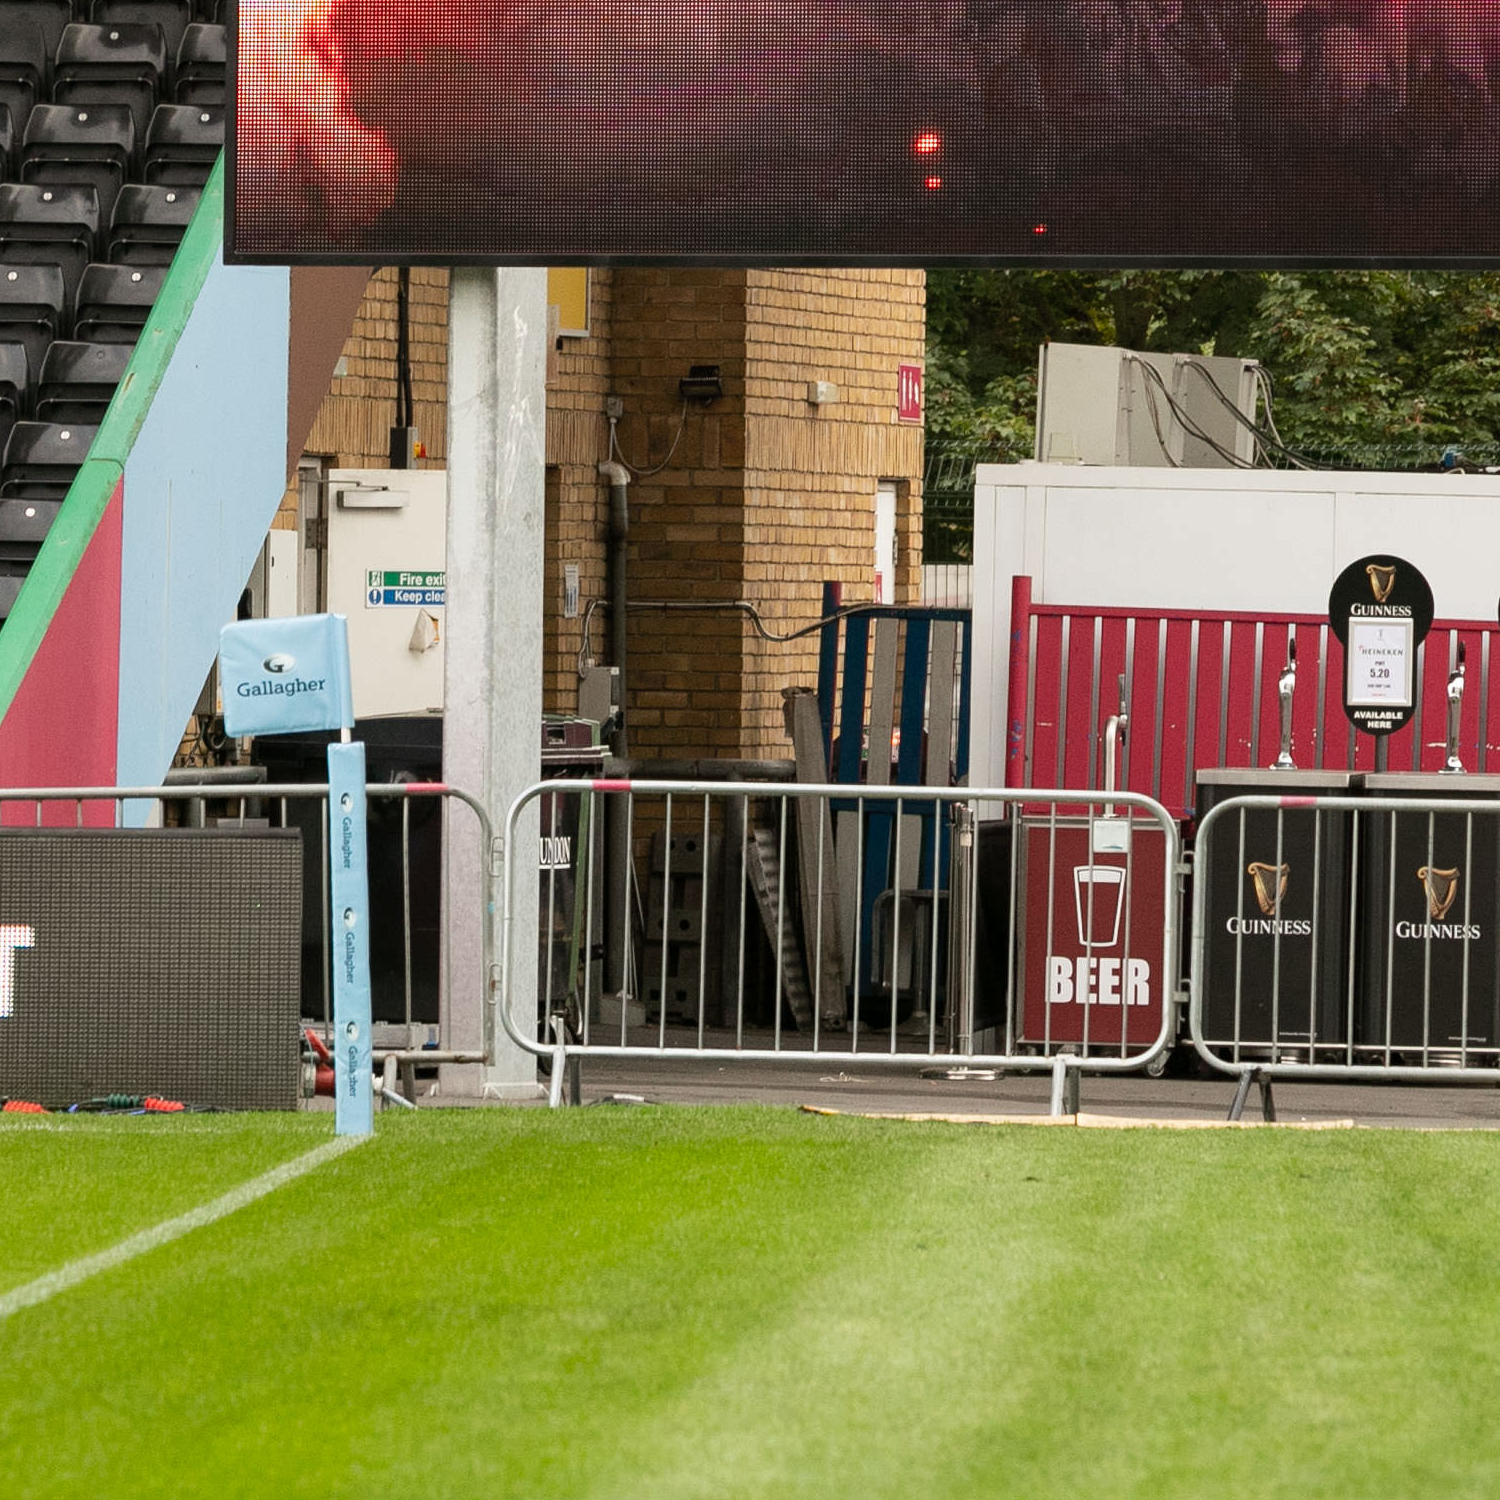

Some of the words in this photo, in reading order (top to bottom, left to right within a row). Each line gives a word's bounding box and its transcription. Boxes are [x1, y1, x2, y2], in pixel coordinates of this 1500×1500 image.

[400, 573, 423, 586] Fire
[395, 590, 423, 605] Keep
[425, 590, 445, 602] clea
[1350, 602, 1412, 618] GUINNESS
[1361, 648, 1404, 657] HEINEKEN
[1370, 668, 1390, 678] 5.20
[237, 677, 327, 698] Gallagher
[1353, 710, 1404, 721] AVAILABLE
[1367, 720, 1393, 730] HERE
[342, 816, 352, 869] Gallagher
[540, 835, 571, 864] UNDON
[1226, 916, 1312, 936] GUINNESS
[1395, 920, 1482, 940] GUINNESS
[344, 931, 355, 984] Gallagher
[1048, 956, 1150, 1005] BEER
[347, 1045, 358, 1098] Gallaher
